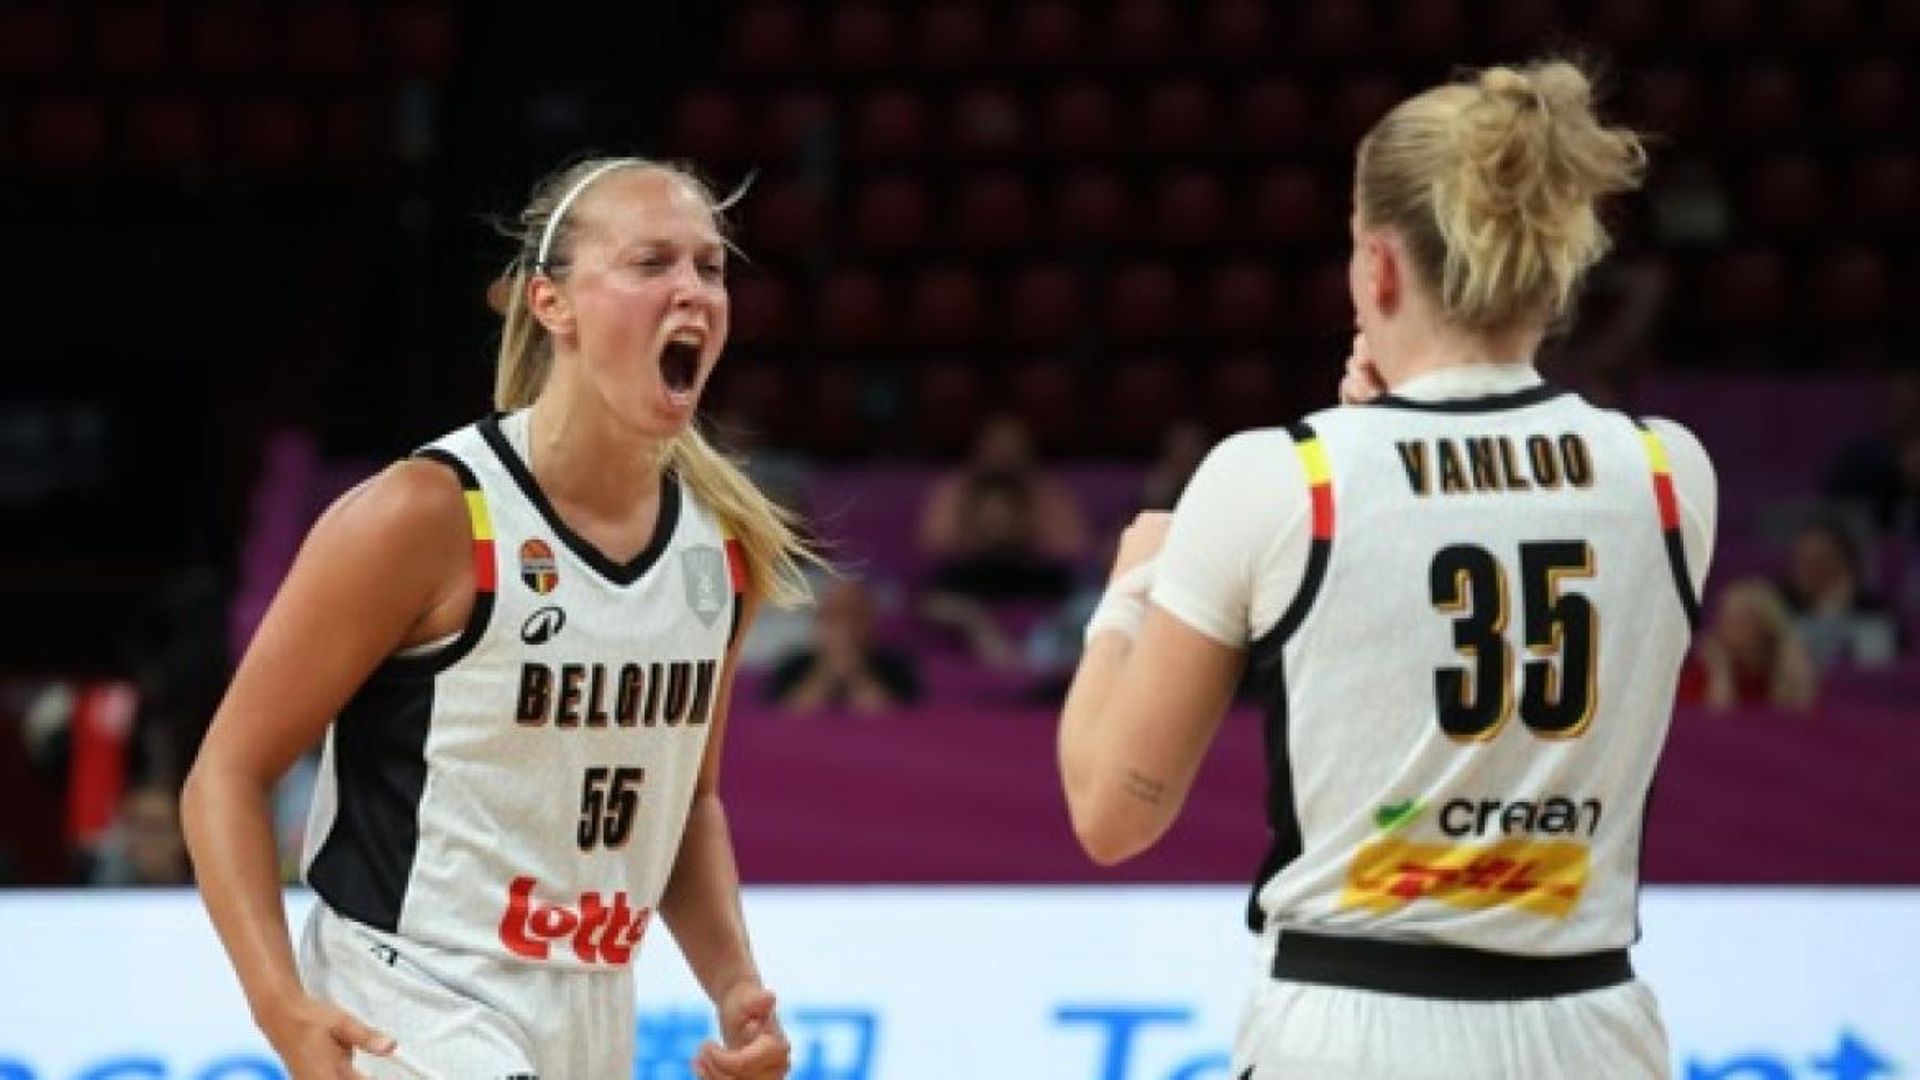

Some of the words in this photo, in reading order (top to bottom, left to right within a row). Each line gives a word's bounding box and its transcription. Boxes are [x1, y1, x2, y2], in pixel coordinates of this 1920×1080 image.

[1395, 432, 1594, 496] VANLOO
[1428, 540, 1598, 742] 35
[577, 767, 644, 851] 55
